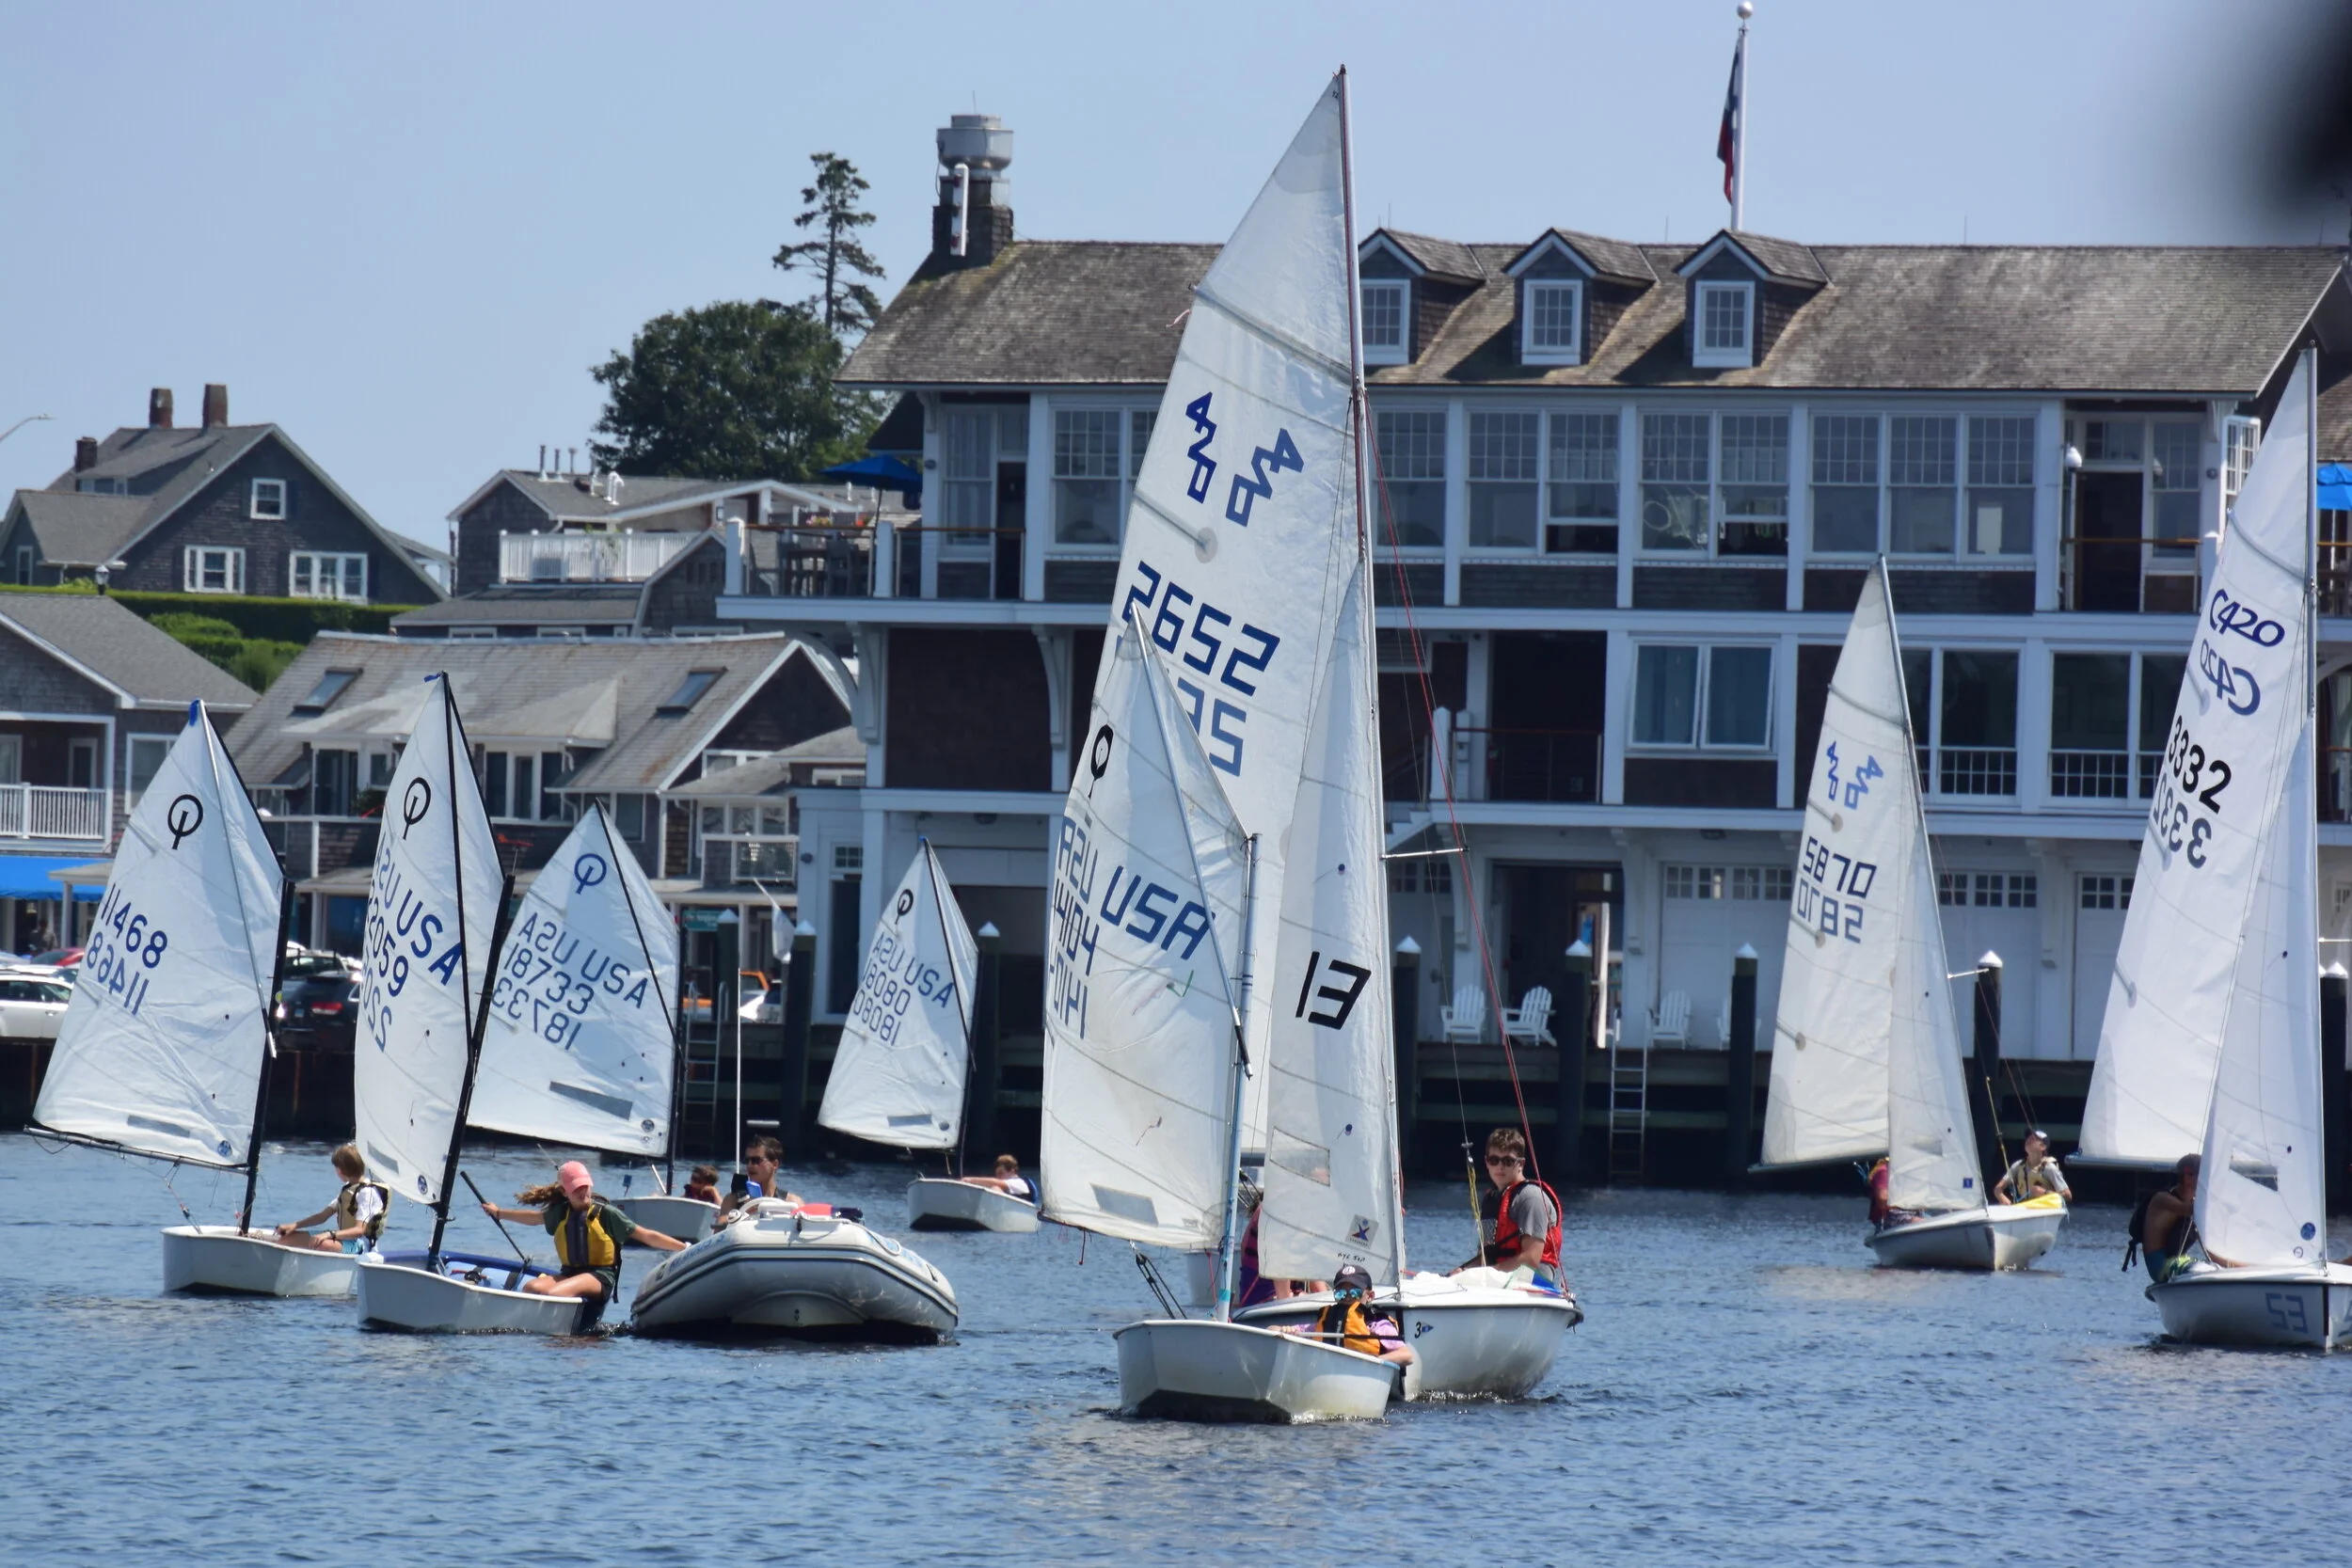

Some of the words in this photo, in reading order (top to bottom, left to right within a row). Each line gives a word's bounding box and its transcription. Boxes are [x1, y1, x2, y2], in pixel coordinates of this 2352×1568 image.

[1185, 391, 1217, 504] 420
[1121, 561, 1280, 696] 2652
[2210, 588, 2285, 647] C420
[1826, 741, 1839, 800] 420
[2169, 715, 2232, 815] 3332
[1803, 836, 1877, 899] 5870
[101, 882, 167, 969] 11468
[396, 889, 462, 987] USA
[1100, 865, 1216, 960] USA
[503, 942, 595, 1015] 18733
[580, 949, 648, 1009] USA
[863, 958, 911, 1016] 18080
[903, 958, 954, 1008] USA
[1295, 951, 1371, 1031] 13
[1414, 1322, 1422, 1338] 3
[2265, 1292, 2309, 1334] 53
